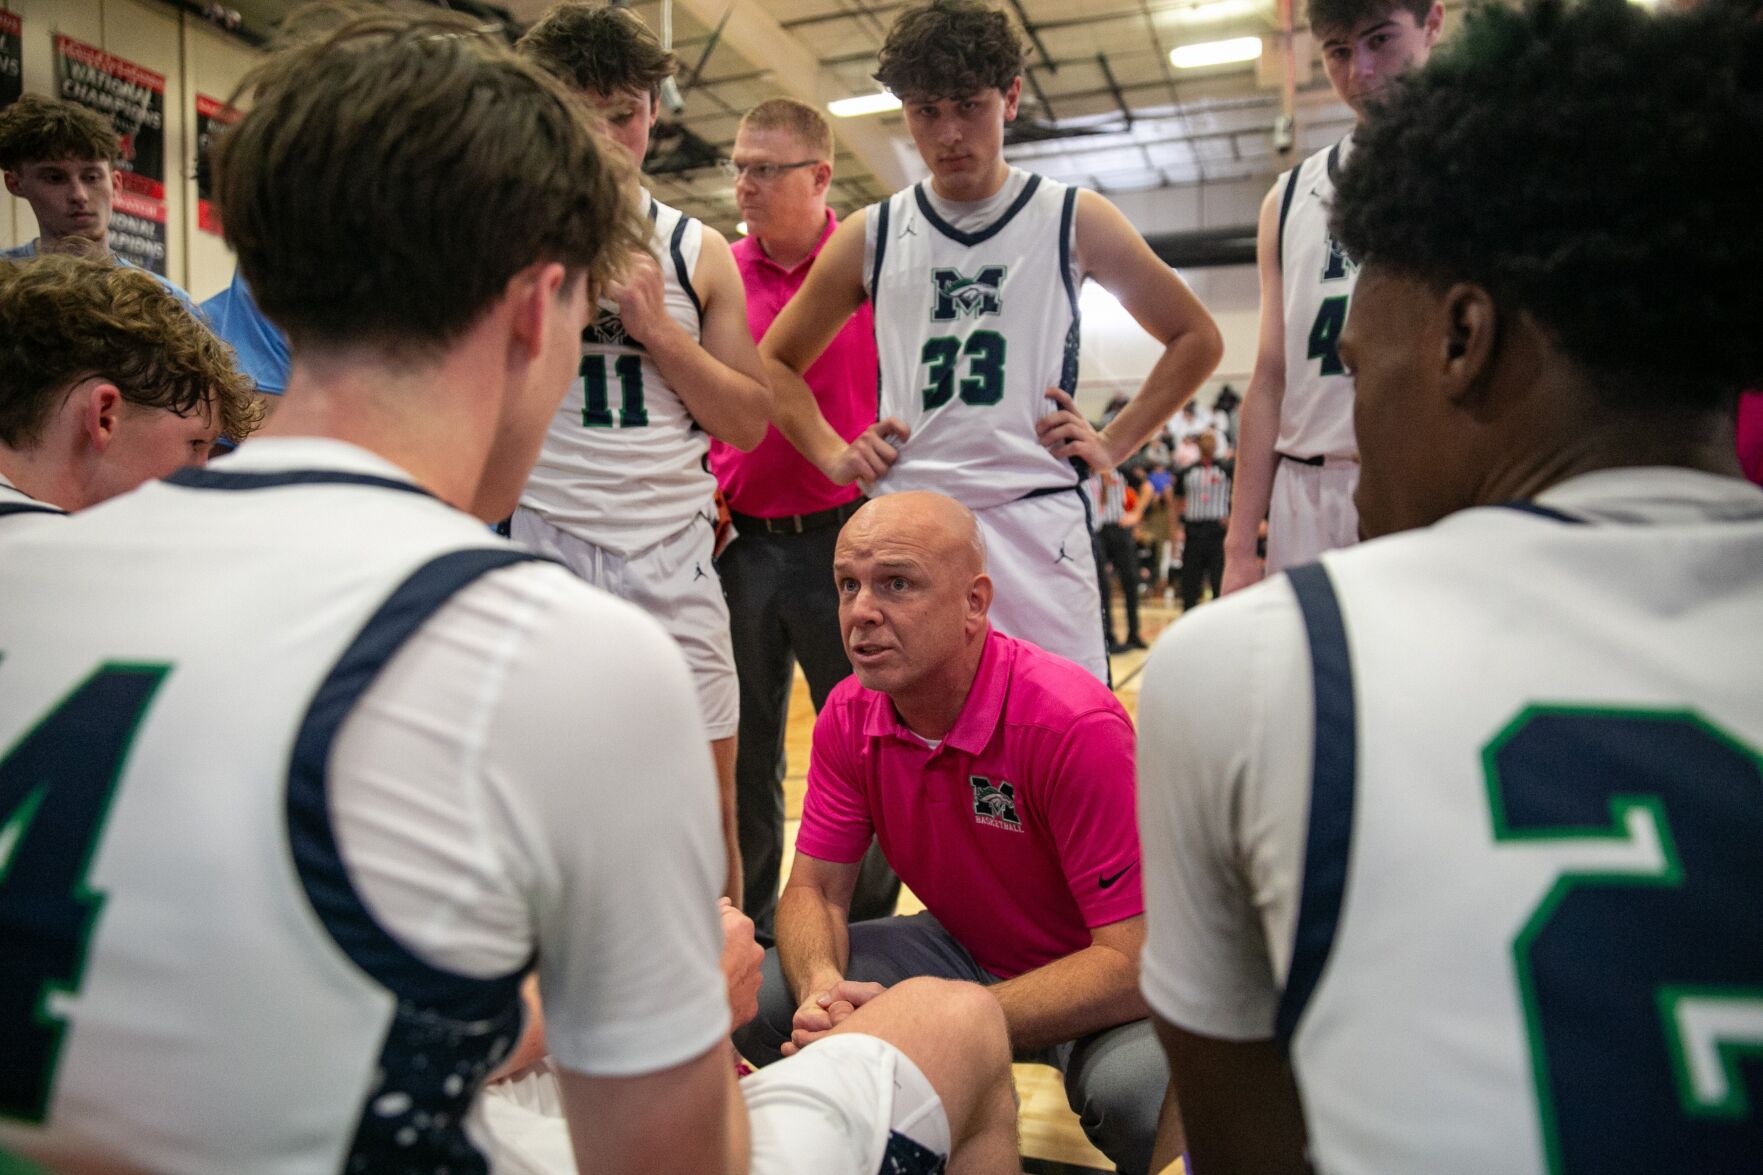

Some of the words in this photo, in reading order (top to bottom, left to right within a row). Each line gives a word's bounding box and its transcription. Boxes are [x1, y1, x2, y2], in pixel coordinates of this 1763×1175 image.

[110, 210, 155, 238] IONAL
[922, 330, 1006, 411] 33
[1307, 295, 1349, 377] 4
[579, 354, 648, 428] 11
[975, 815, 1025, 833] BASKETBALL
[1479, 702, 1763, 1175] 2
